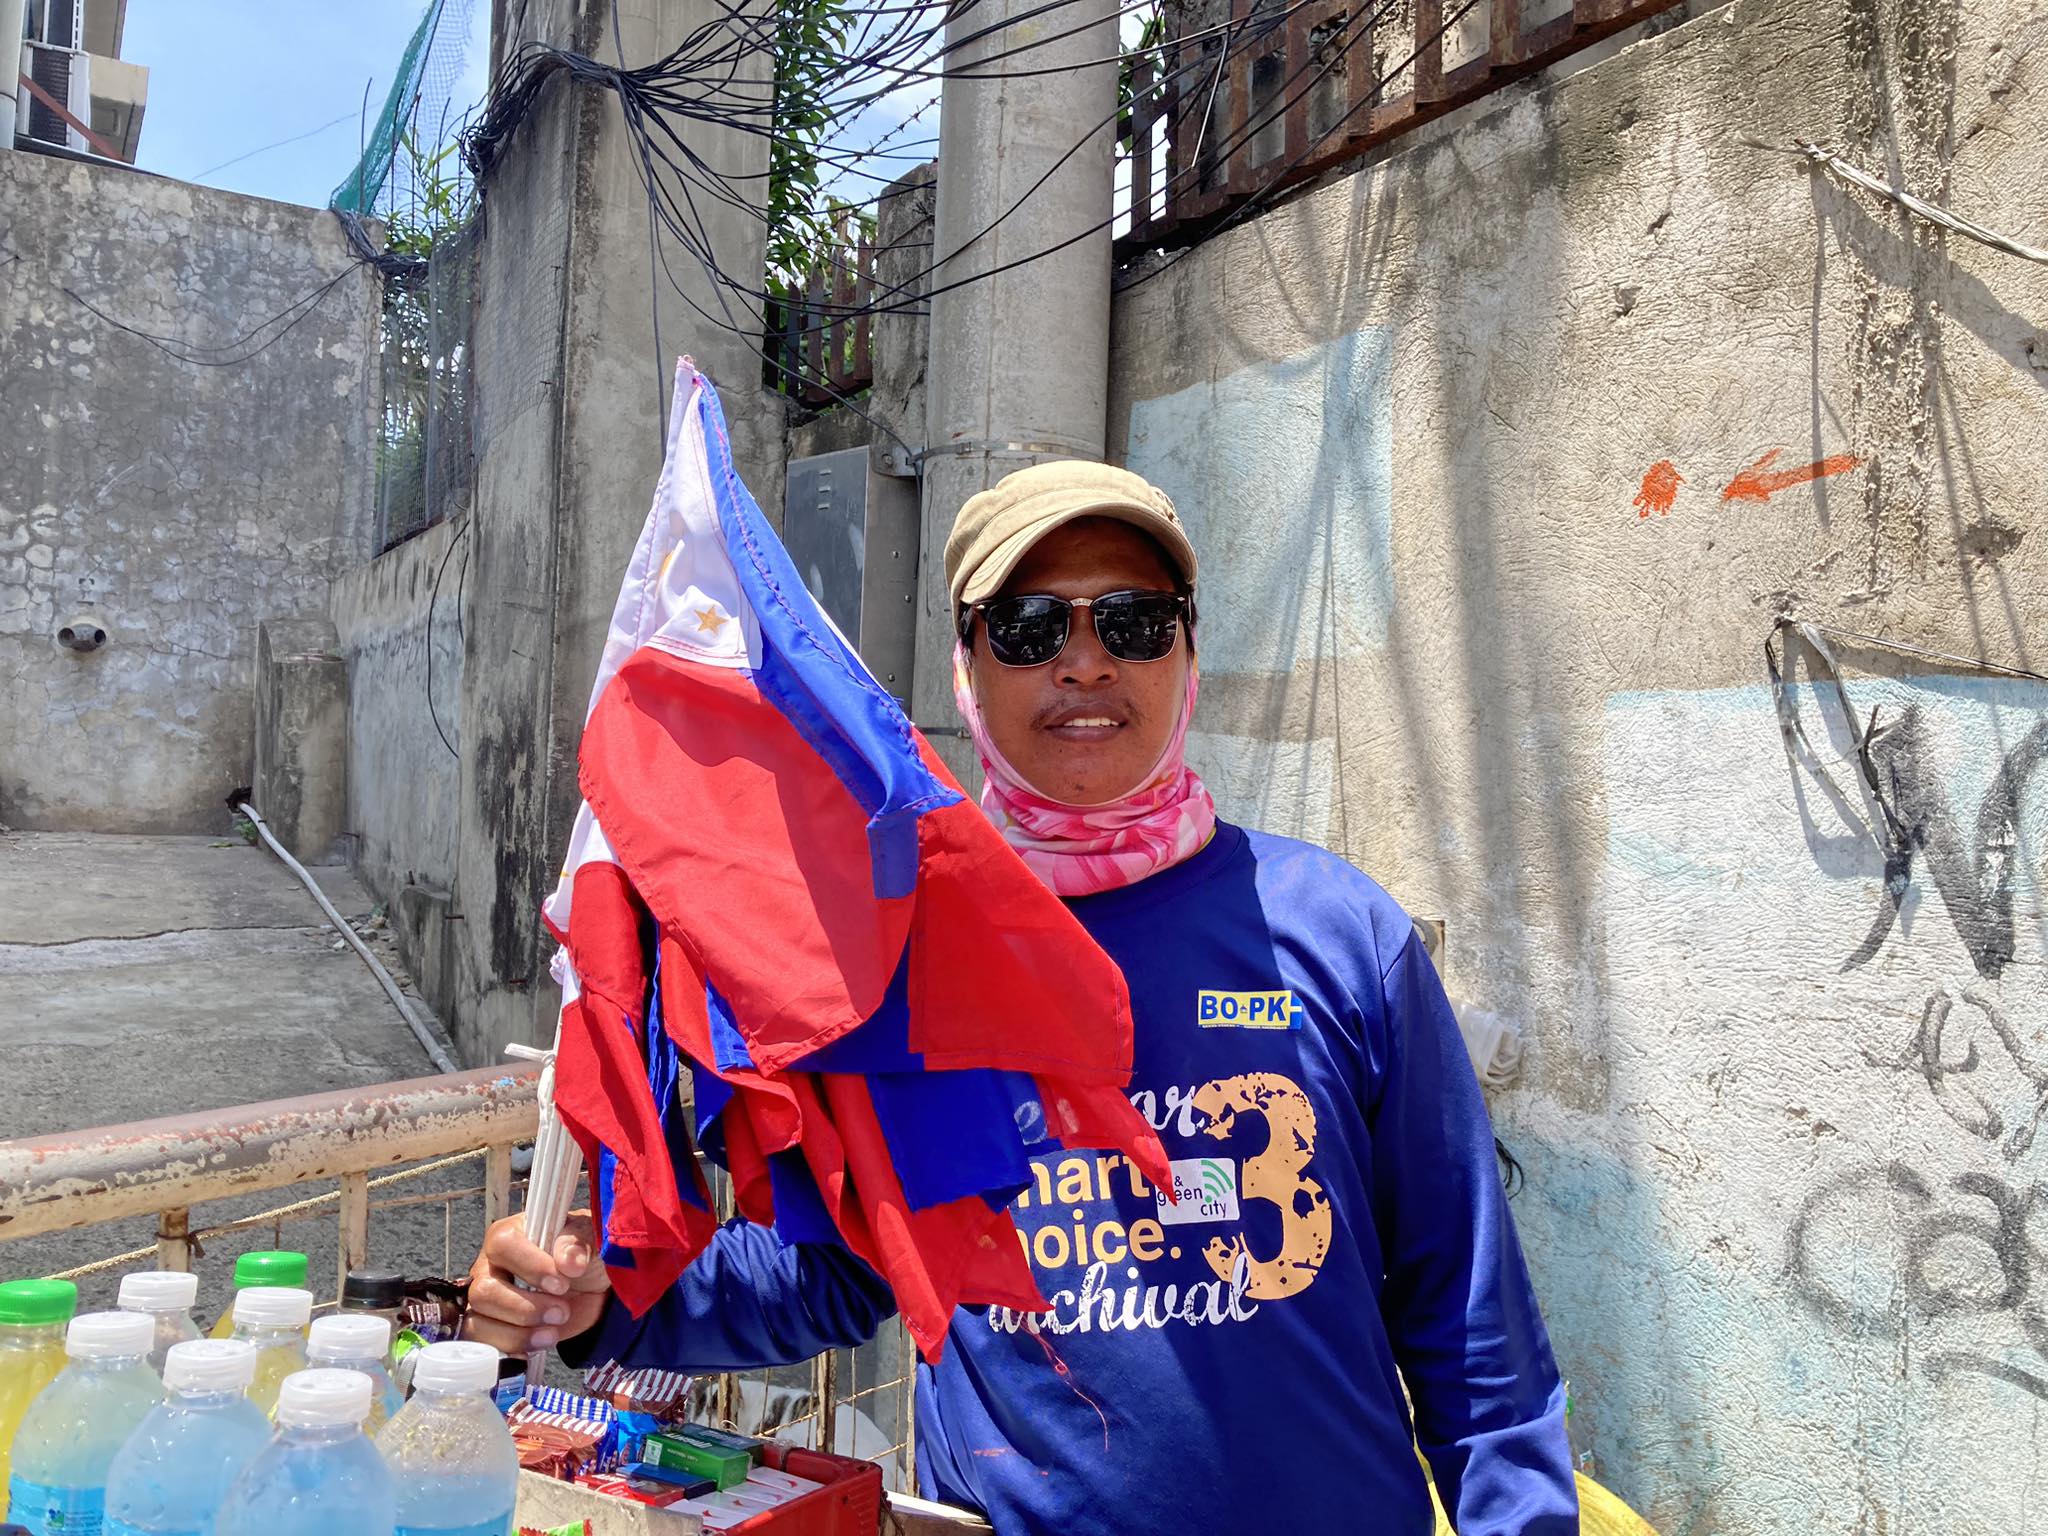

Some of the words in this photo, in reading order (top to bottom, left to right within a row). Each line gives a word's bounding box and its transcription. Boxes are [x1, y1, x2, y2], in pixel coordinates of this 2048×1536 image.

[1174, 1175, 1184, 1187] &
[1192, 1072, 1333, 1301] 3
[1157, 1187, 1203, 1206] geen
[1200, 1200, 1226, 1218] city
